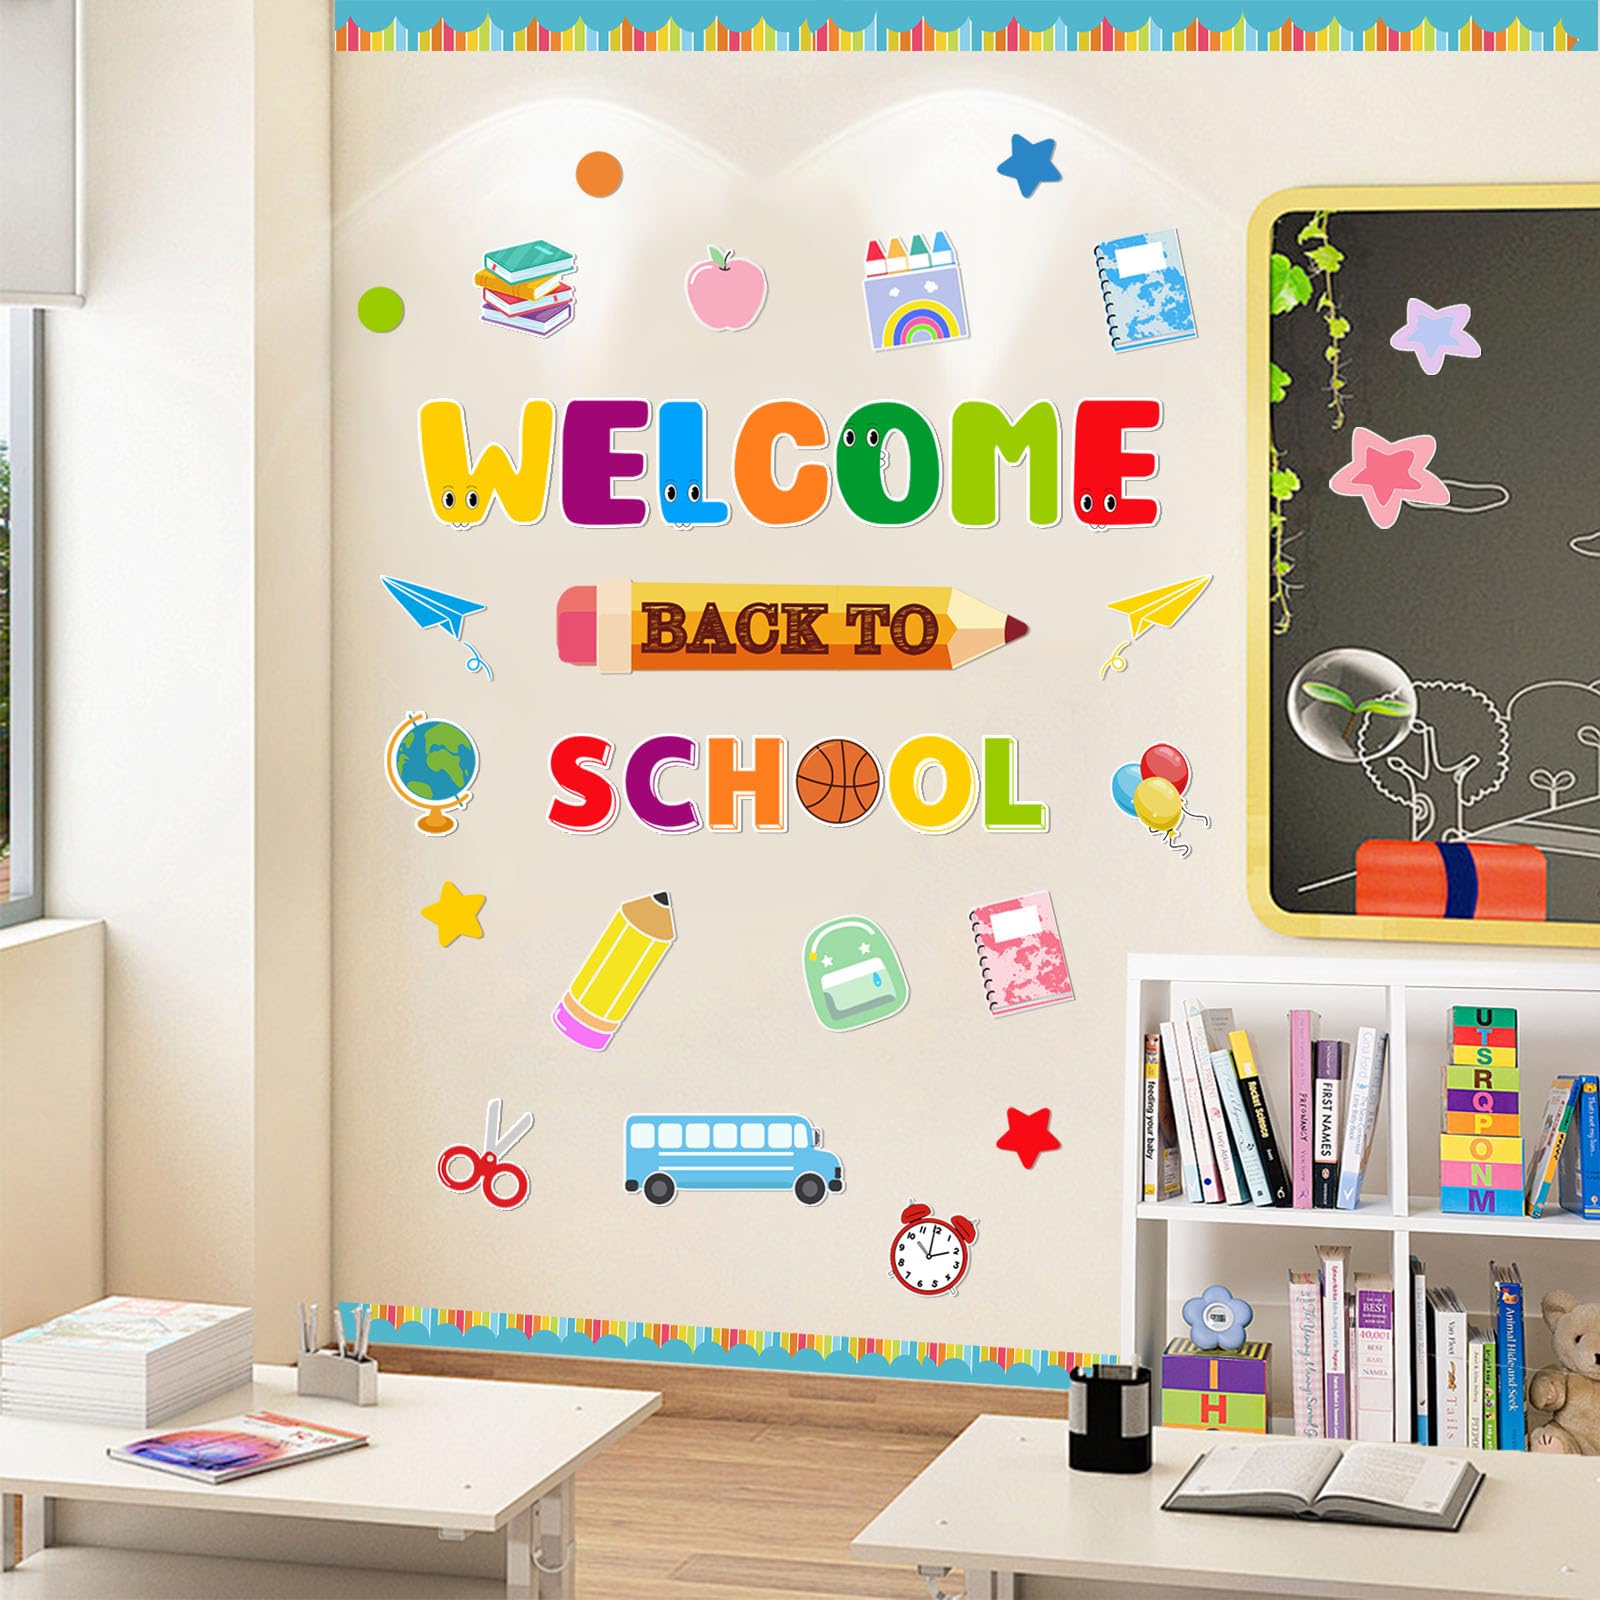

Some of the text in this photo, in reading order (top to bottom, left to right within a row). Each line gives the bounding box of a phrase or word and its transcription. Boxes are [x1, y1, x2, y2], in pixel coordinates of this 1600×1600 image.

[419, 399, 1162, 528] WELCOME
[640, 601, 939, 656] BACK TO
[1476, 1008, 1493, 1027] U
[1476, 1028, 1492, 1045] T
[1476, 1047, 1493, 1065] S
[1474, 1069, 1493, 1089] R
[1248, 1081, 1263, 1108] Rocket
[1472, 1091, 1494, 1114] Q
[1145, 1081, 1157, 1160] feeding your baby
[1254, 1108, 1270, 1139] Science
[1298, 1092, 1308, 1143] PREGNANCY
[1320, 1082, 1333, 1157] FIRST NAMES
[1474, 1115, 1493, 1135] P
[1215, 1131, 1231, 1172] Lucy Atkins
[1470, 1138, 1493, 1161] O
[1471, 1164, 1493, 1187] N
[1468, 1190, 1495, 1213] M
[906, 1231, 916, 1240] 10
[919, 1225, 927, 1234] 11
[947, 1234, 952, 1242] 1
[898, 1243, 905, 1251] 9
[953, 1247, 960, 1255] 2
[897, 1258, 905, 1267] 8
[953, 1260, 960, 1269] 3
[905, 1271, 911, 1279] 7
[917, 1279, 923, 1288] 6
[931, 1279, 938, 1288] 5
[1303, 1305, 1316, 1321] The
[1362, 1303, 1387, 1313] BEST
[1360, 1330, 1390, 1340] 40,001
[1505, 1307, 1518, 1343] Animal
[1298, 1323, 1314, 1357] Yummy
[1447, 1320, 1457, 1356] Van Fleet
[1209, 1359, 1219, 1390] I
[1362, 1368, 1388, 1376] NAMES
[1200, 1393, 1227, 1424] H
[1445, 1396, 1459, 1440] Tails
